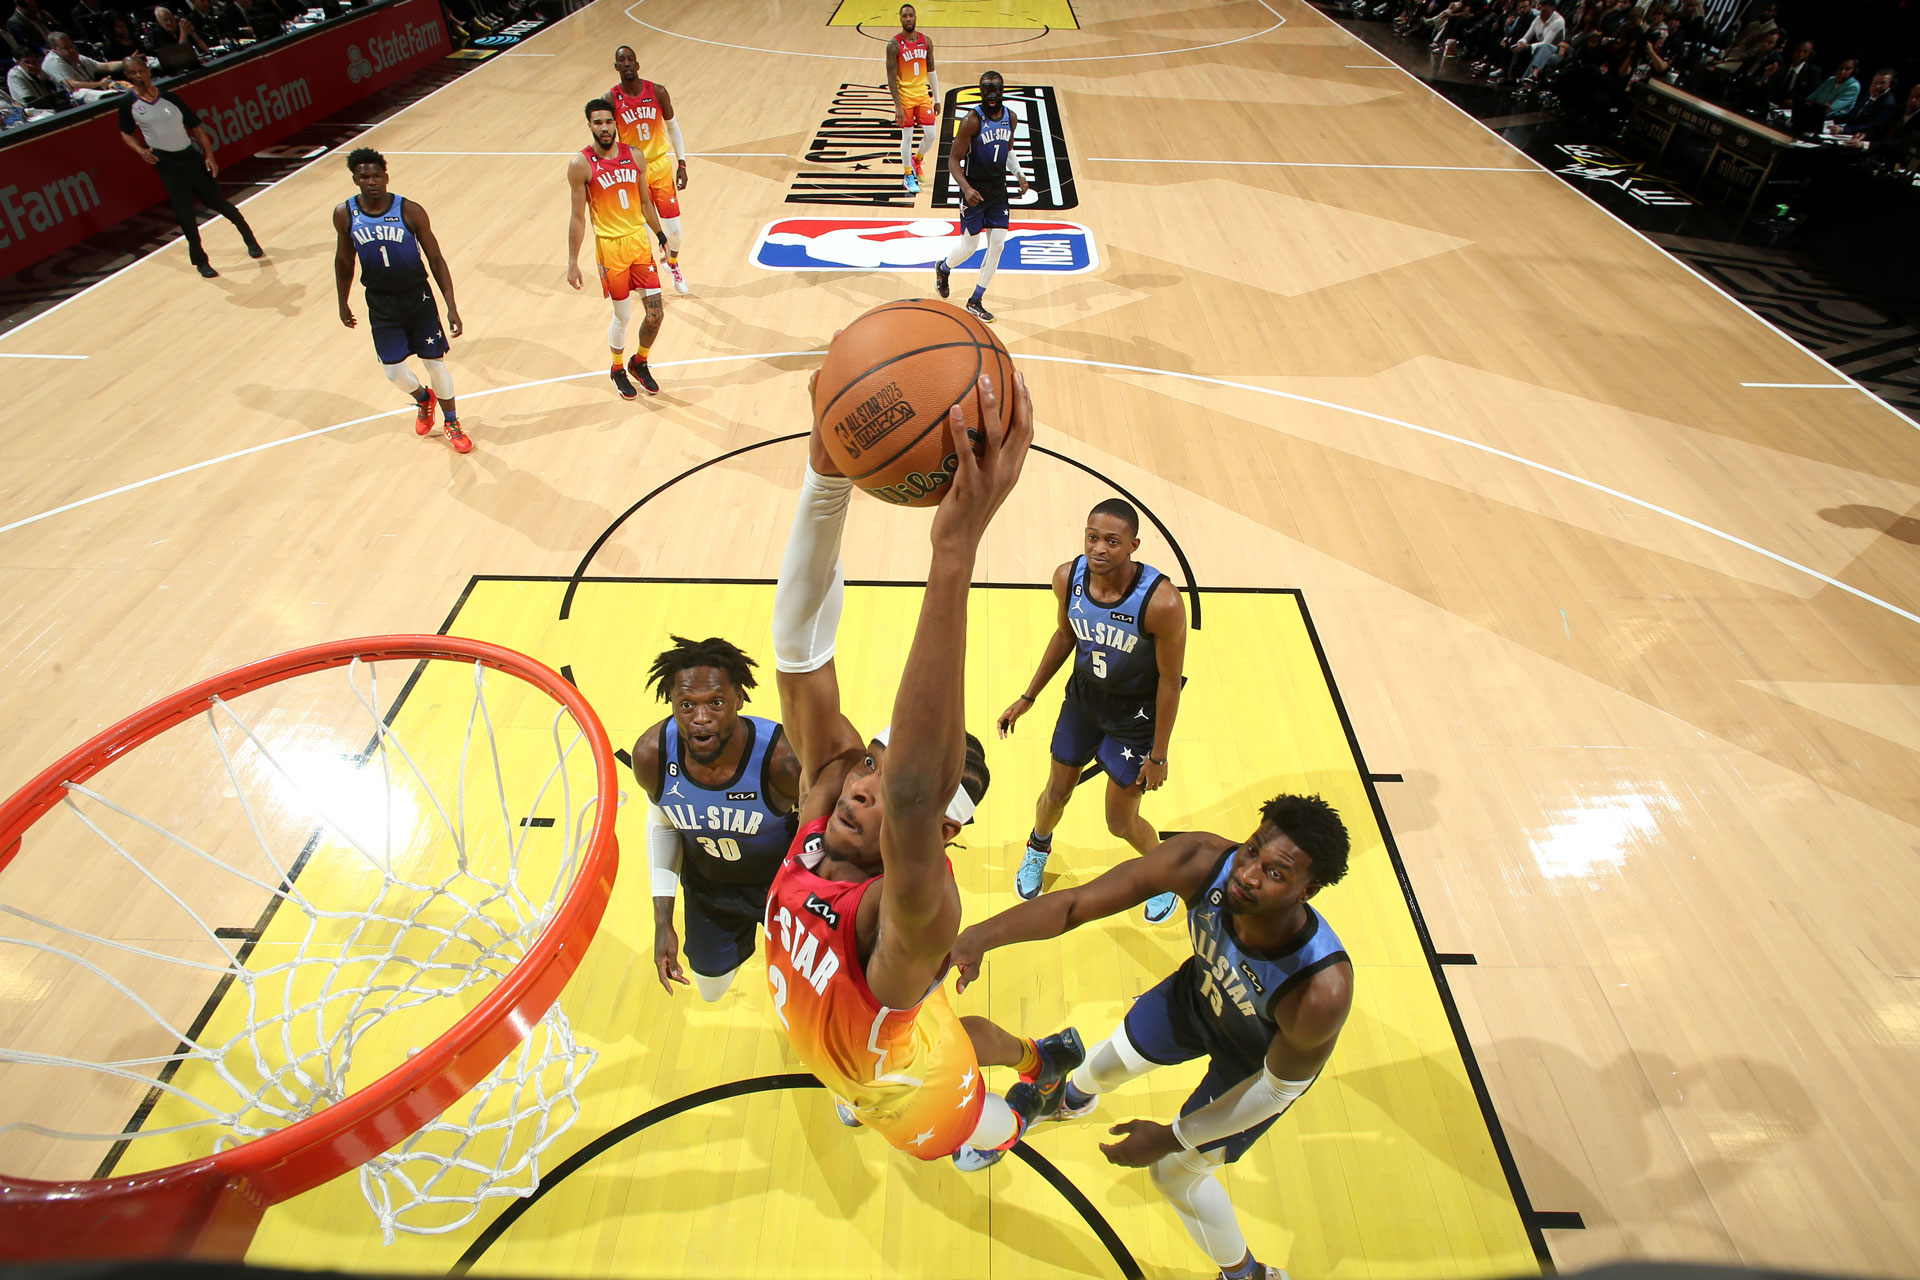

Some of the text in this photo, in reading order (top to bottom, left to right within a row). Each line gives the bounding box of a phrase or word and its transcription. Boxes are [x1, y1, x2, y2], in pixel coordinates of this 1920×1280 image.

[913, 61, 920, 76] 0
[621, 106, 657, 125] ALL-STAR
[636, 122, 651, 141] 13
[993, 144, 1000, 163] 7
[597, 168, 637, 190] ALL-STAR
[617, 188, 630, 210] 0
[352, 224, 405, 246] ALL-STAR
[380, 245, 390, 267] 1
[1019, 239, 1074, 266] NBA
[1075, 585, 1082, 596] 6
[1091, 650, 1107, 679] 5
[669, 763, 678, 776] 6
[662, 804, 764, 835] ALL-STAR
[696, 836, 742, 861] 30
[1210, 890, 1222, 905] 6
[769, 964, 790, 1032] 2
